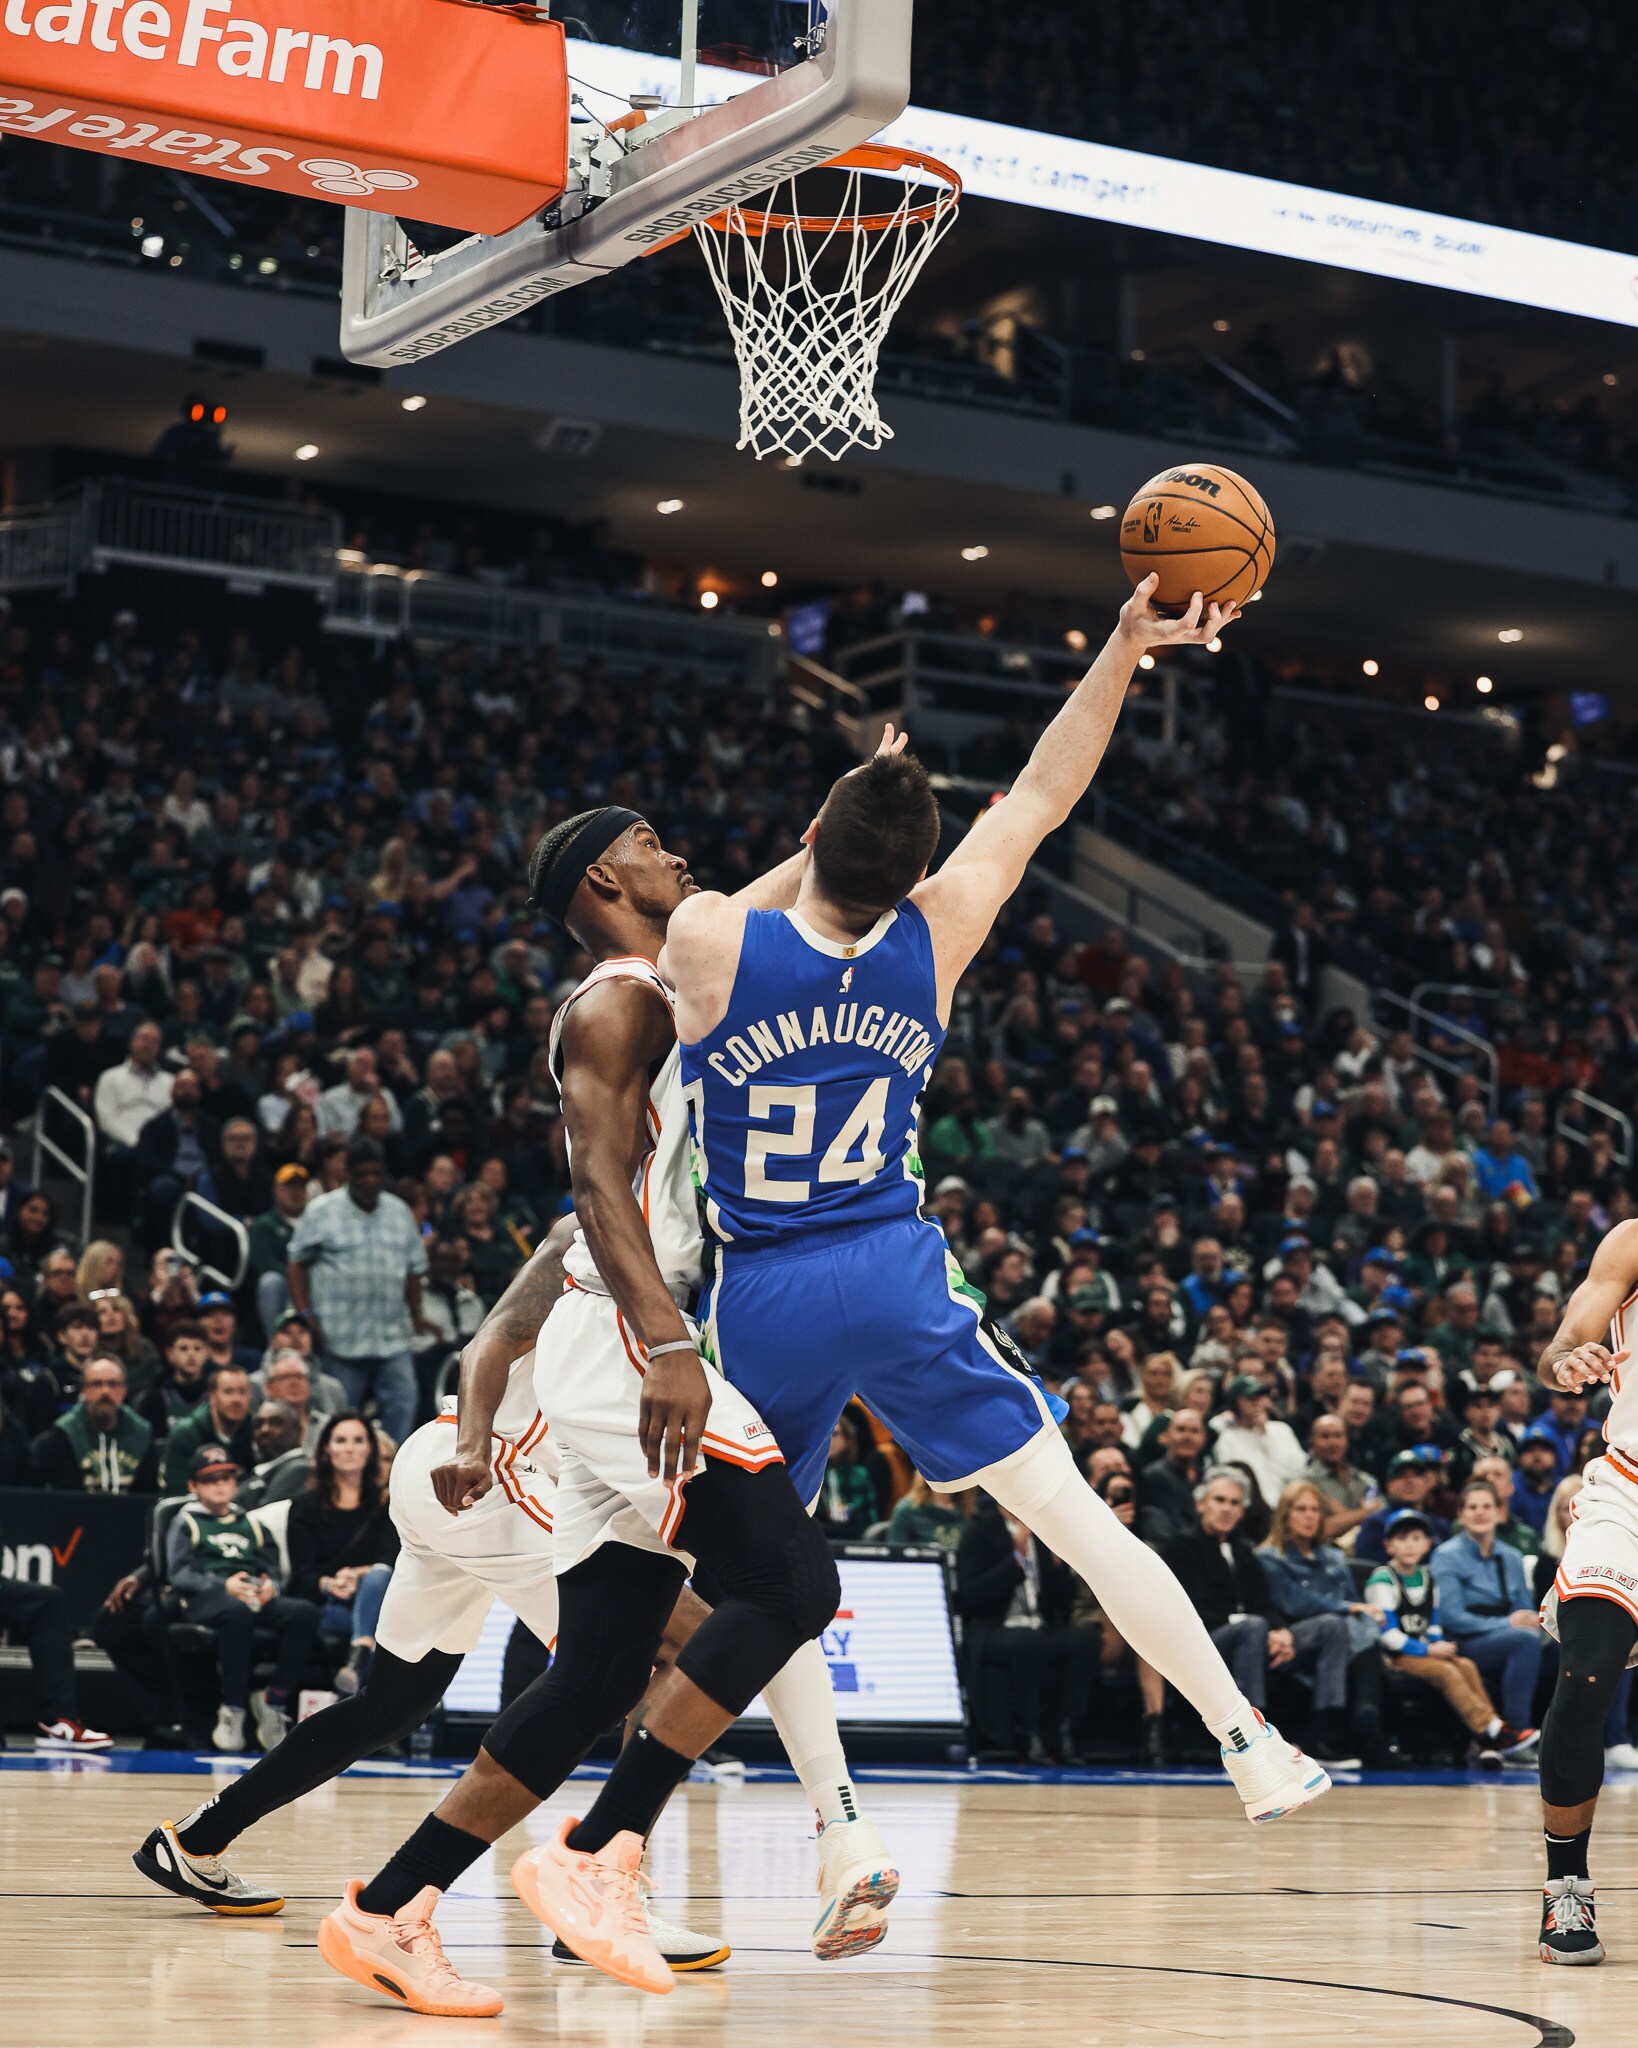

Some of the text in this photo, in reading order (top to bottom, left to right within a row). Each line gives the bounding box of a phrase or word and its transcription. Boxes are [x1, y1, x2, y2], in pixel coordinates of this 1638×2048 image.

[624, 145, 841, 243] SHOP.BUCKS.COM
[389, 277, 571, 359] SHOP.BUCKS.COM
[707, 1003, 936, 1087] CONNAUGHTON
[744, 1077, 890, 1202] 24
[1578, 1567, 1637, 1589] MIAMI
